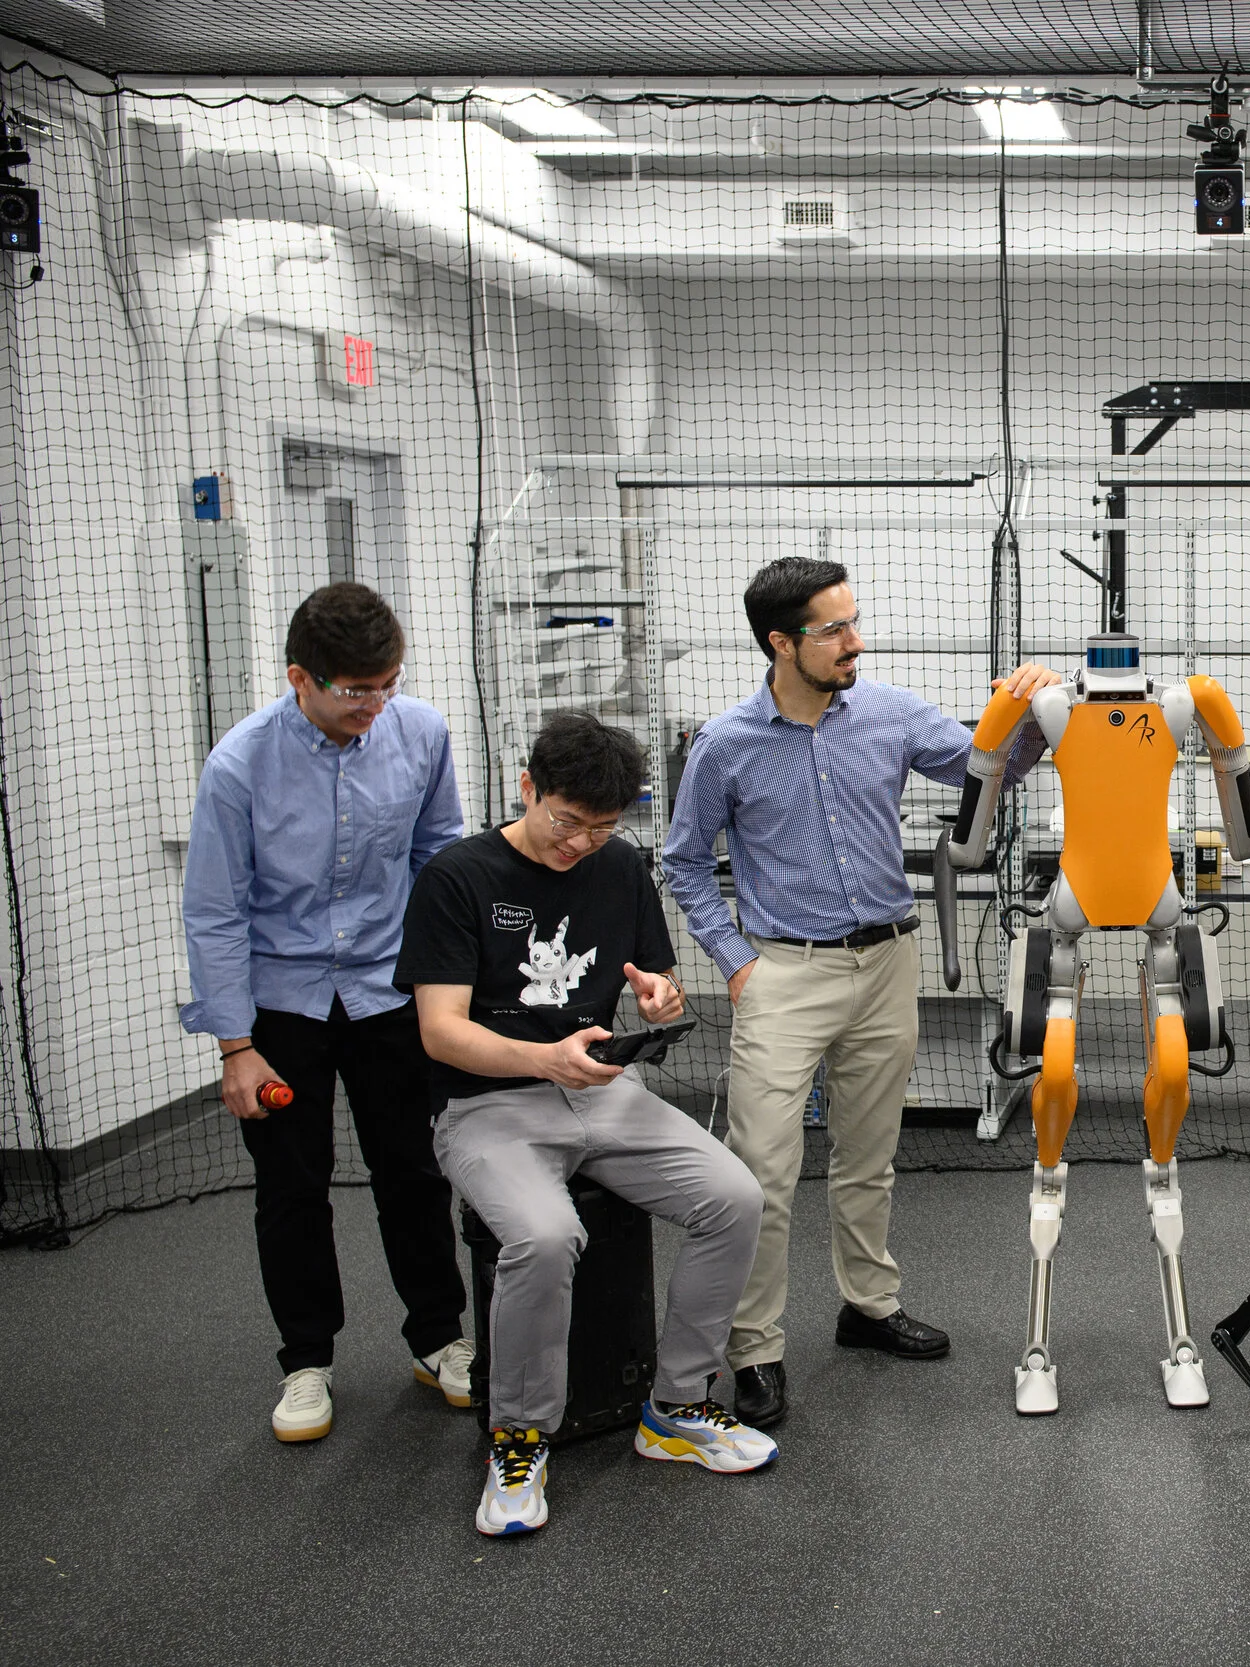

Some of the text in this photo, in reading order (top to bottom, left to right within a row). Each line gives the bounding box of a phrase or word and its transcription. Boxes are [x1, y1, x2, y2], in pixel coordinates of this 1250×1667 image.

[11, 234, 18, 243] 3
[343, 334, 374, 388] EXIT
[498, 907, 530, 918] CRYSTAL
